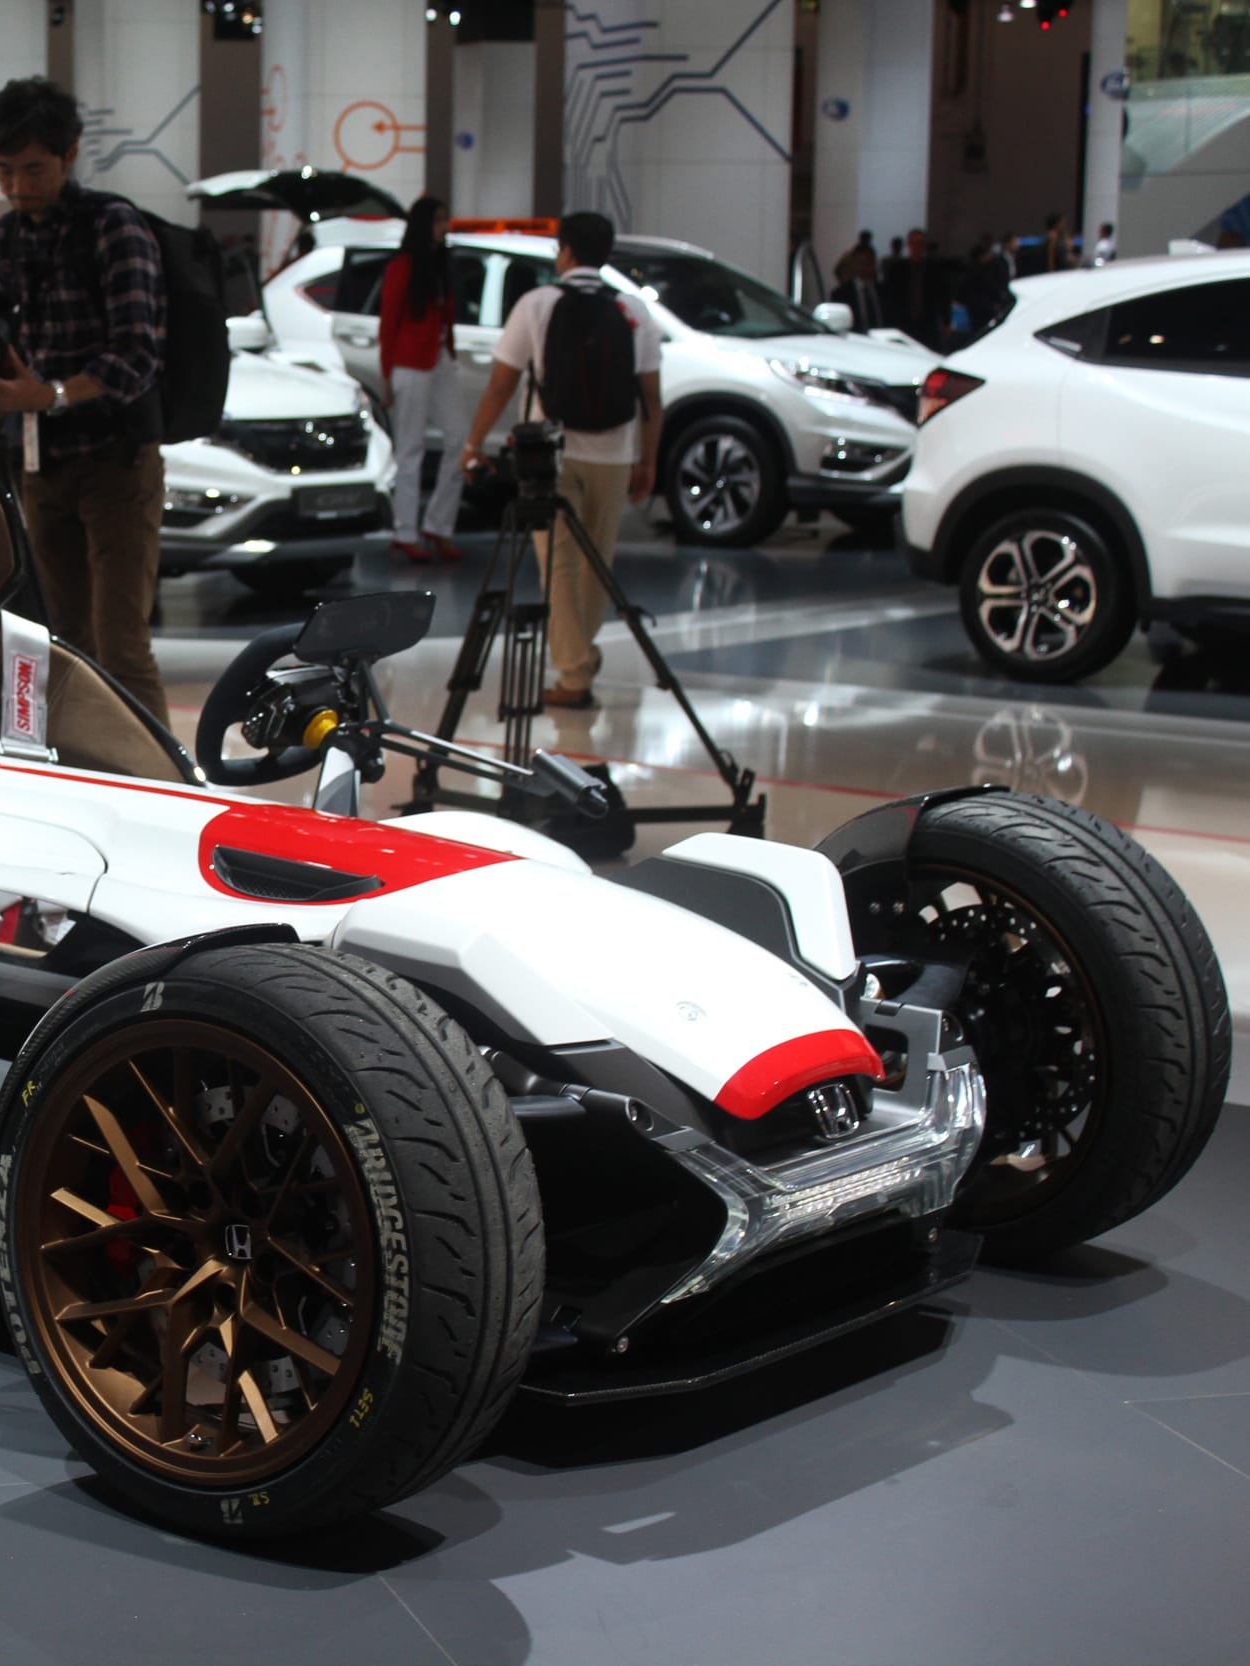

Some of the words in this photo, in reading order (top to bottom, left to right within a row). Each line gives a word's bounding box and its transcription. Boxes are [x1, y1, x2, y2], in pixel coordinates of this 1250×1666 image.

[17, 660, 33, 732] SIMPSON
[22, 1080, 36, 1107] FR
[343, 1118, 409, 1366] BRIDGESTONE
